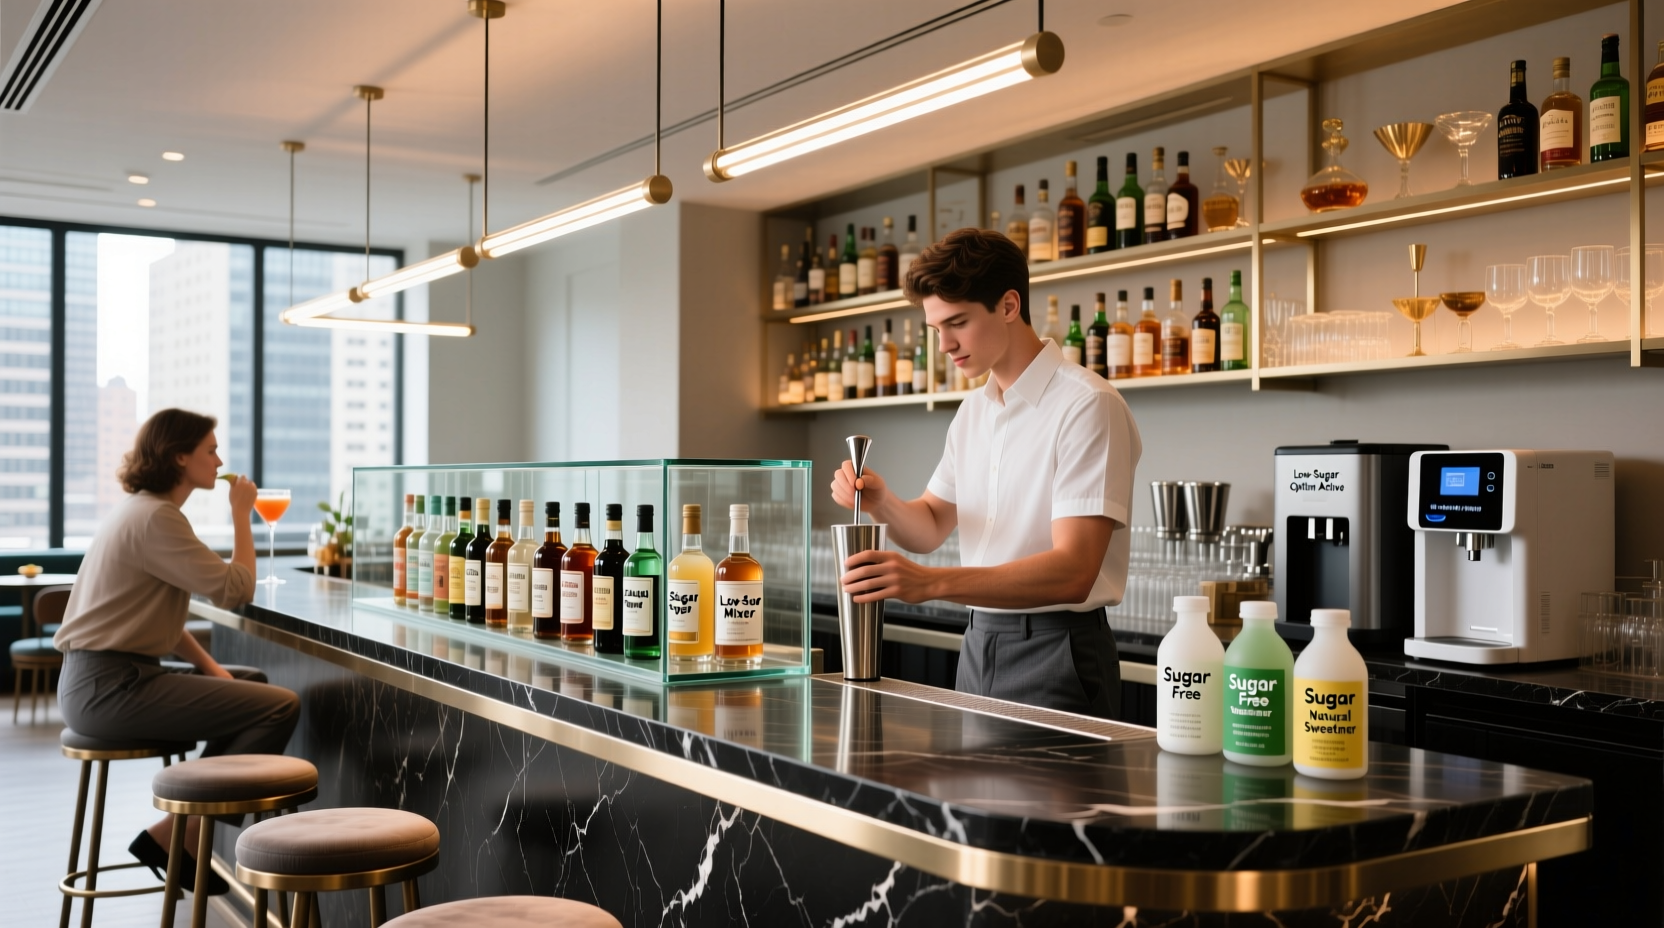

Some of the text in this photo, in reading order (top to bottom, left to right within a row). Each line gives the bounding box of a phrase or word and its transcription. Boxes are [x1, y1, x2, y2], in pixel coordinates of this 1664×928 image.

[724, 608, 756, 619] Mixer
[1164, 667, 1211, 686] Sugar
[1229, 674, 1278, 692] Sugar
[1172, 686, 1201, 700] Free
[1305, 688, 1356, 709] Sugar
